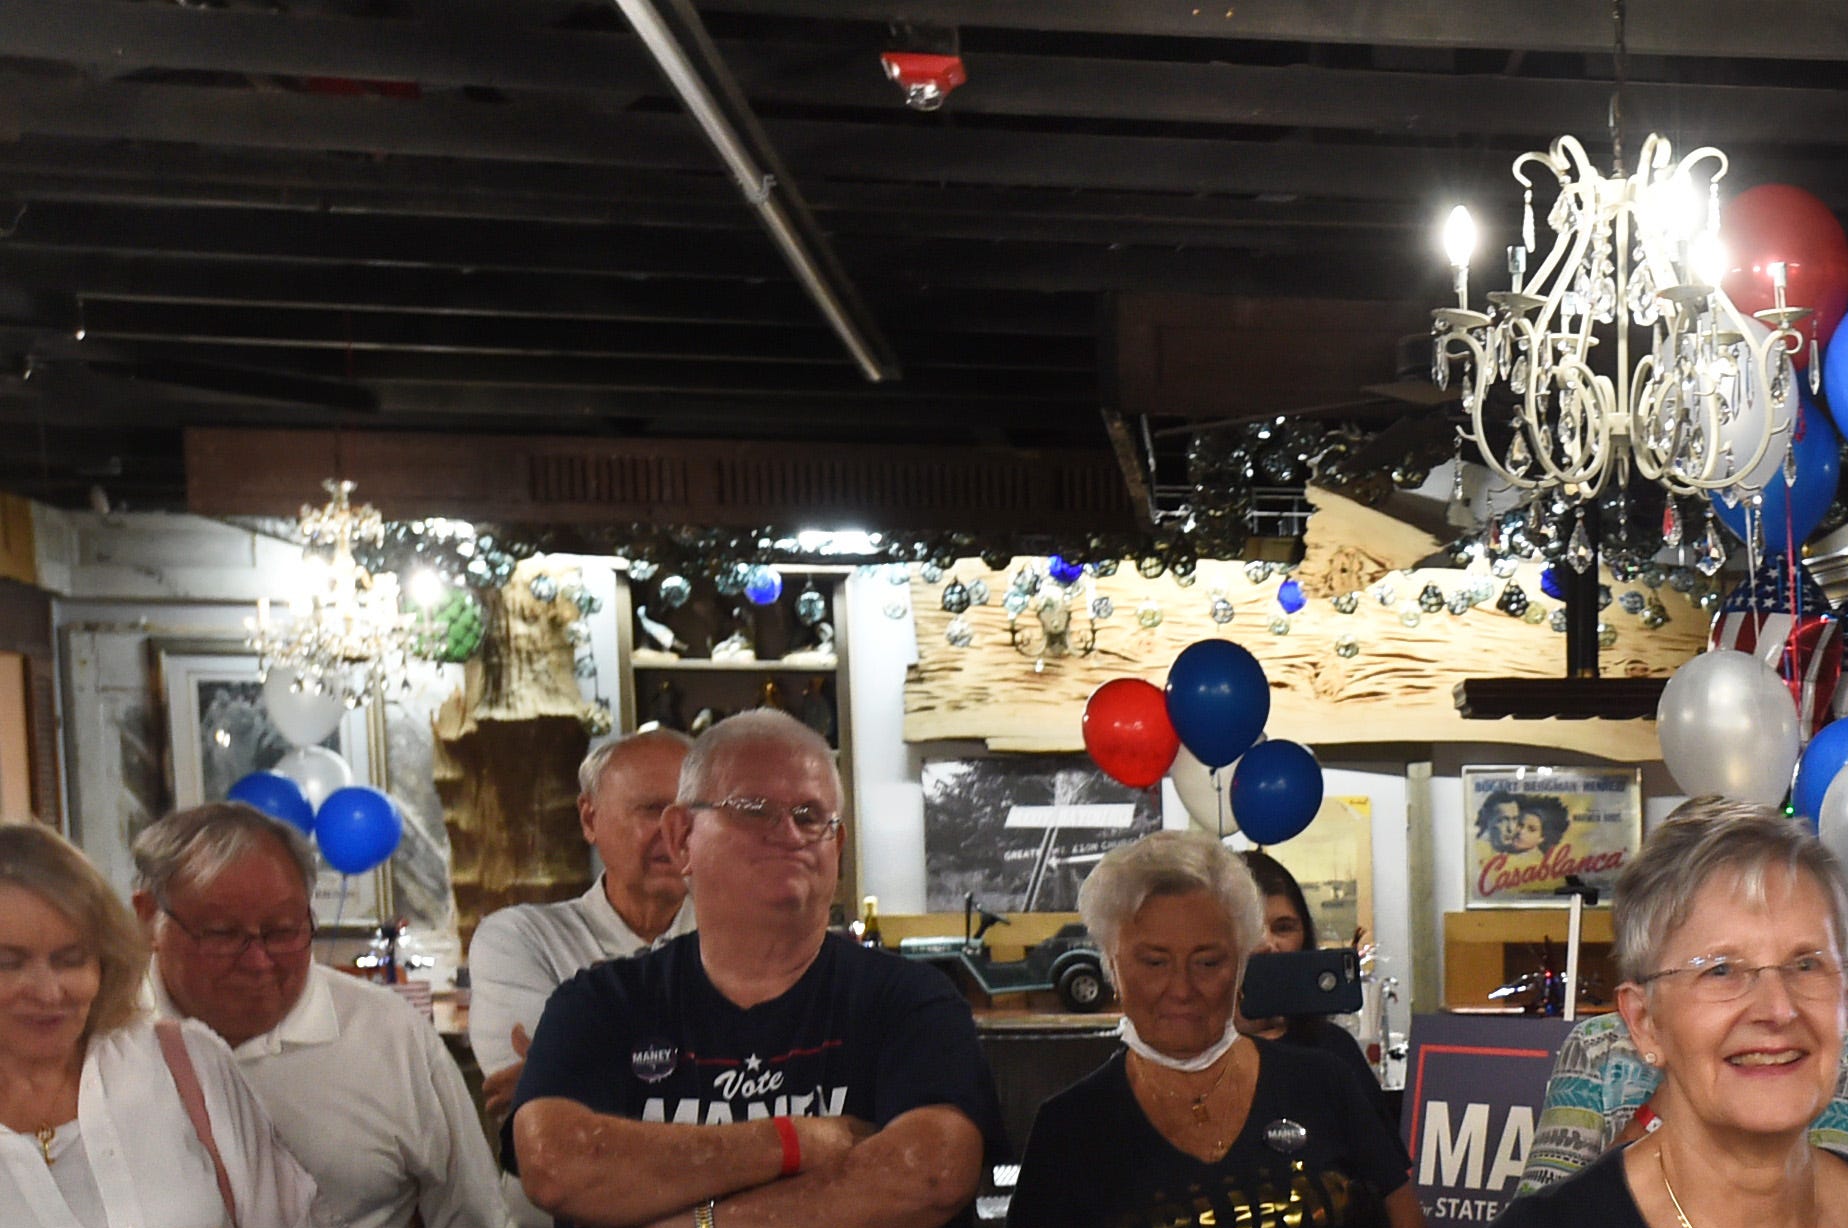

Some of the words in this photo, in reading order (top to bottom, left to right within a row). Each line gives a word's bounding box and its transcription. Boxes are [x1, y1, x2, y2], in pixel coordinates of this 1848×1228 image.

[632, 1048, 671, 1065] MANEY
[713, 1069, 785, 1100] Vote
[1434, 1196, 1498, 1221] STATE
